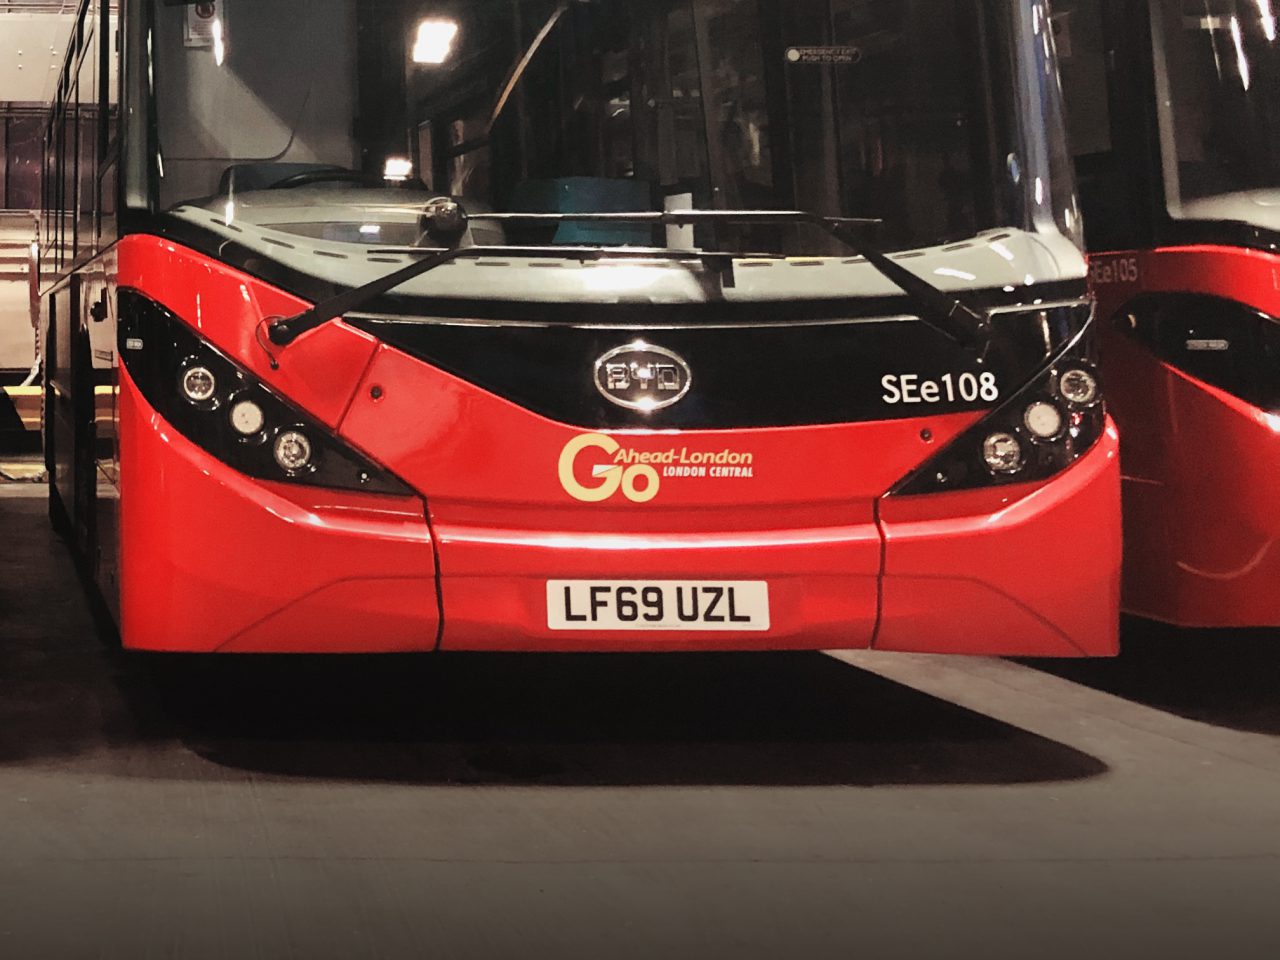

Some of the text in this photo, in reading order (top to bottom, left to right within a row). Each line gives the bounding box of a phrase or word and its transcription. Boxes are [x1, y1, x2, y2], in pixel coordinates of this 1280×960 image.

[606, 362, 680, 390] BYD
[881, 372, 999, 405] SEe108
[558, 433, 660, 503] Go
[613, 447, 753, 465] Ahead-London
[663, 466, 754, 478] LONDON CENTRAL
[564, 586, 751, 622] LF69 UZL
